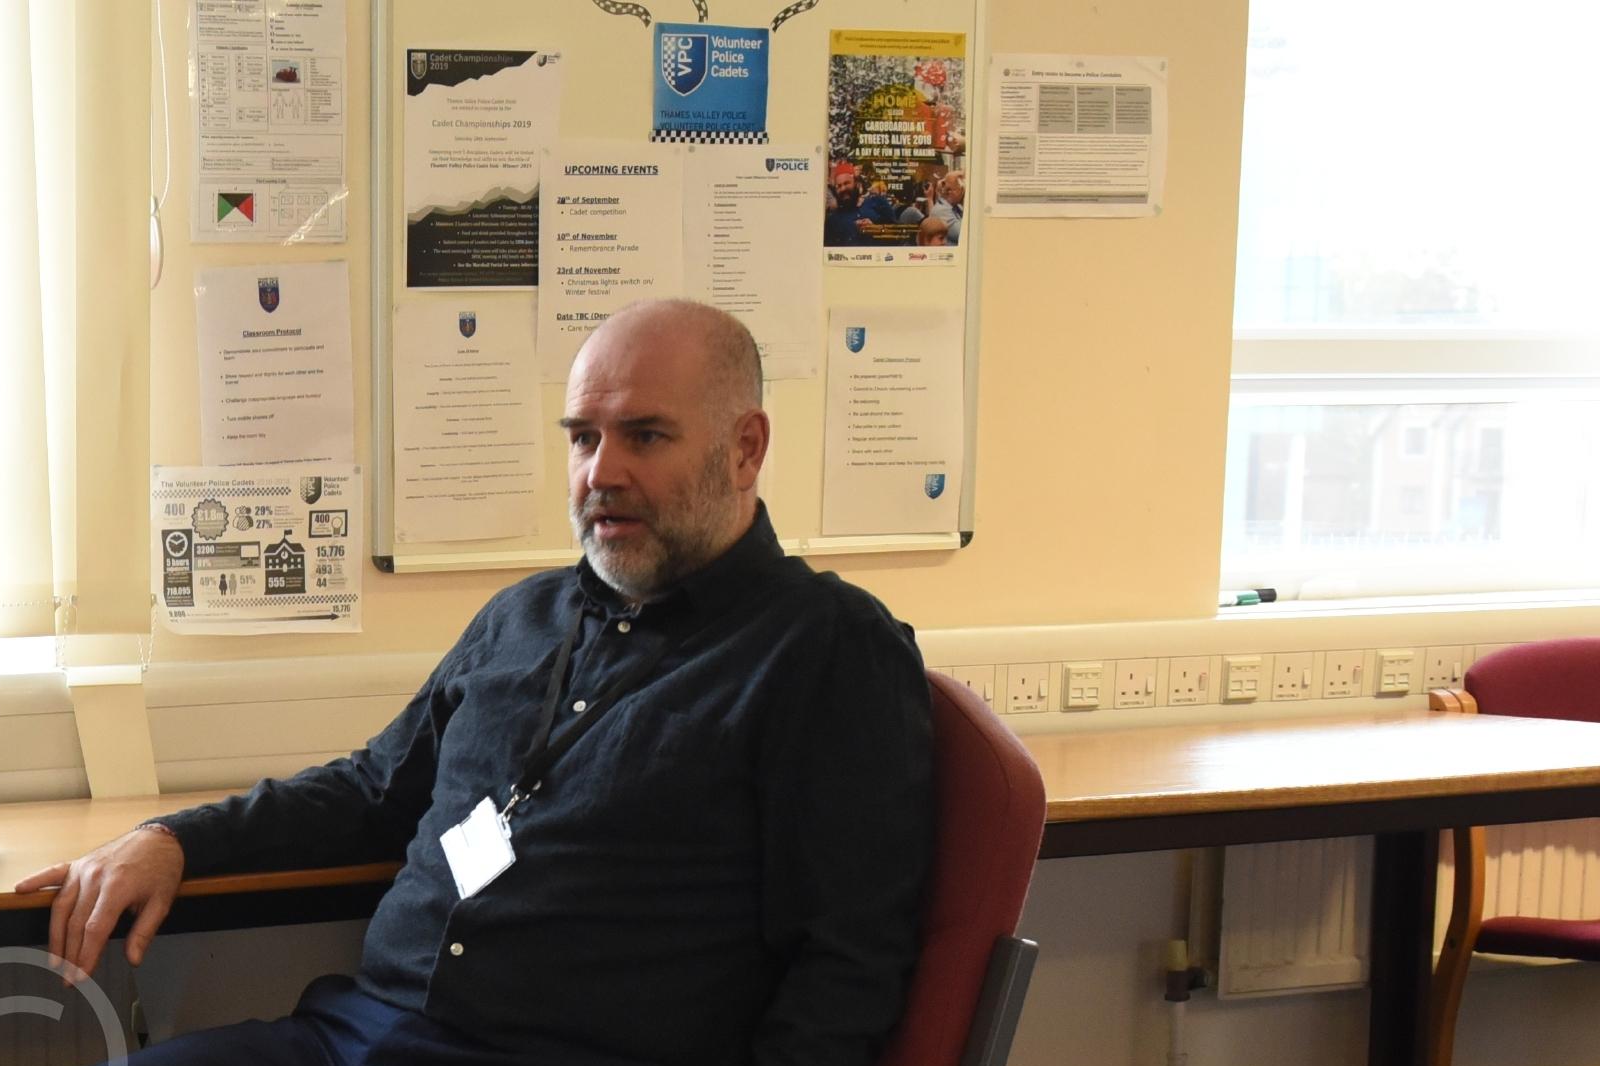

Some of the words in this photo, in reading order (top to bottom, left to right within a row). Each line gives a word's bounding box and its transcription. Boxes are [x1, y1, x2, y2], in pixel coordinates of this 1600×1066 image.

[711, 36, 763, 50] Volunteer
[430, 54, 452, 63] Cadet
[453, 54, 514, 63] Championships
[677, 37, 693, 77] VPC
[711, 51, 744, 63] Police
[430, 62, 449, 71] 2019
[711, 65, 749, 79] Cadets
[873, 94, 917, 108] HOME
[660, 110, 690, 119] THAMES
[691, 110, 720, 120] VALLEY
[721, 111, 747, 120] POLICE
[432, 119, 453, 128] Cadet
[455, 119, 511, 128] Championships
[513, 119, 532, 128] 2019
[859, 133, 890, 145] STREETS
[891, 134, 911, 145] ALIVE
[861, 148, 872, 156] DAY
[873, 149, 881, 157] OF
[882, 149, 893, 157] FUN
[564, 165, 618, 176] UPCOMING
[621, 165, 659, 176] EVENTS
[775, 162, 809, 171] POLICE
[887, 183, 904, 191] FREE
[581, 196, 620, 206] September
[569, 208, 588, 216] Cadet
[589, 208, 627, 218] competition
[572, 234, 580, 242] of
[581, 233, 618, 242] November
[569, 244, 615, 253] Remembrance
[616, 244, 639, 253] Parade
[556, 267, 574, 276] 23rd
[575, 267, 583, 275] of
[583, 267, 621, 276] November
[567, 278, 599, 286] Christmas
[600, 278, 619, 288] lights
[620, 278, 641, 286] switch
[565, 288, 586, 296] Winter
[588, 288, 611, 296] festival
[556, 313, 574, 321] Date
[575, 313, 590, 321] TBC
[242, 329, 276, 339] Classroom
[276, 328, 302, 337] Protocol
[208, 479, 230, 487] Police
[164, 503, 186, 516] 400
[254, 505, 273, 516] 29%
[314, 514, 330, 523] 400
[256, 519, 273, 529] 27%
[196, 545, 215, 555] 3200
[172, 558, 190, 567] hours
[239, 574, 256, 585] 51%
[268, 576, 285, 588] 555
[316, 577, 327, 588] 44
